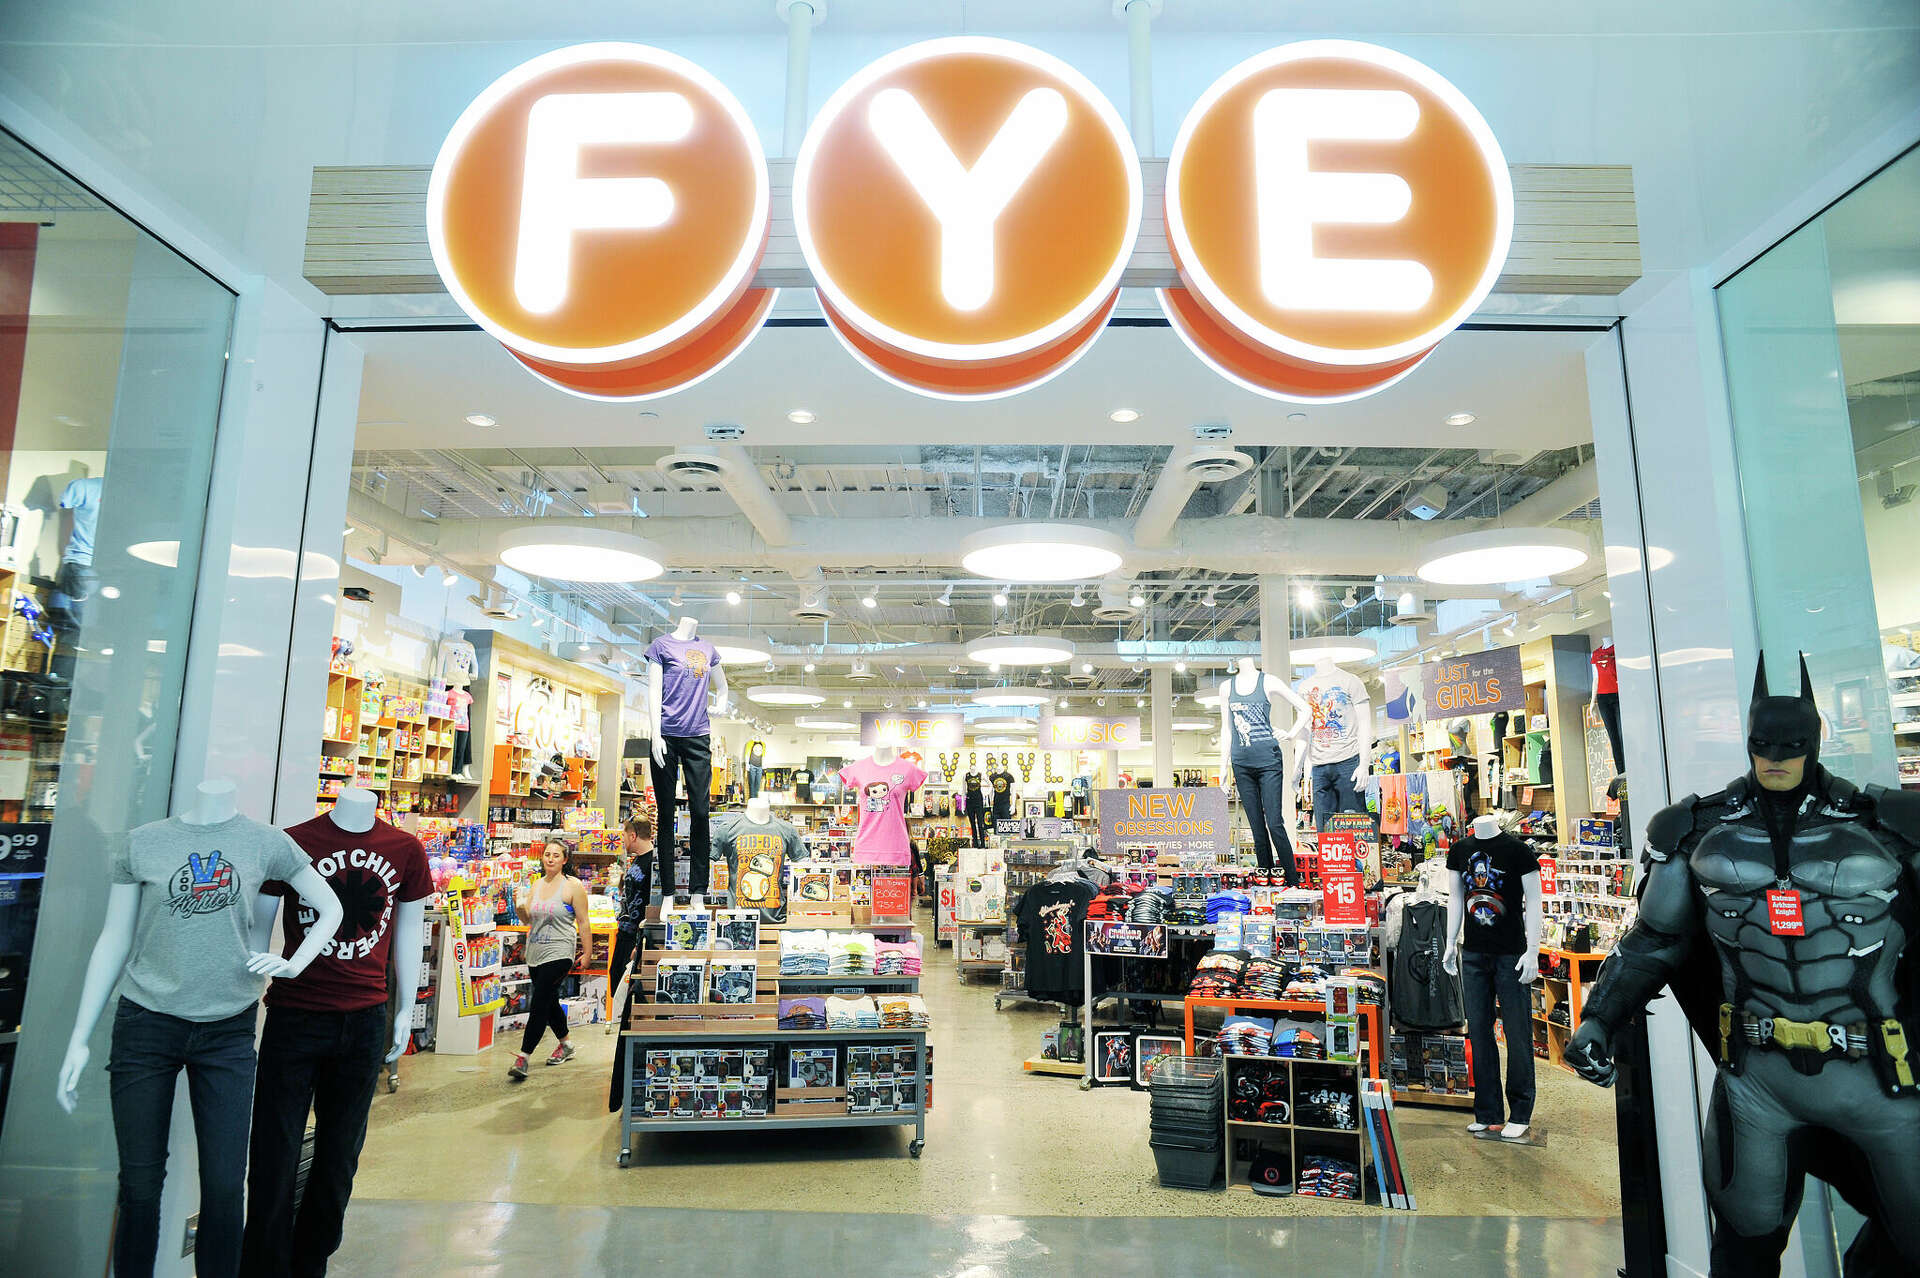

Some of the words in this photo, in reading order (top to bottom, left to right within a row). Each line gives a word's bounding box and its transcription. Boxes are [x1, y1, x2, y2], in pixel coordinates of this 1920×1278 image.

[514, 86, 1433, 314] FYE
[1434, 662, 1470, 684] JUST
[1472, 669, 1481, 678] for
[1482, 667, 1494, 676] the
[1436, 677, 1502, 711] GIRLS
[875, 719, 947, 740] VIDEO
[1051, 722, 1127, 743] MUSIC
[1127, 792, 1196, 819] NEW
[1114, 820, 1214, 836] OBSESSIONS
[1188, 840, 1215, 849] MORE
[1321, 843, 1352, 862] 50%
[317, 850, 347, 877] OT
[1326, 882, 1356, 904] $15
[1126, 929, 1142, 940] WAR
